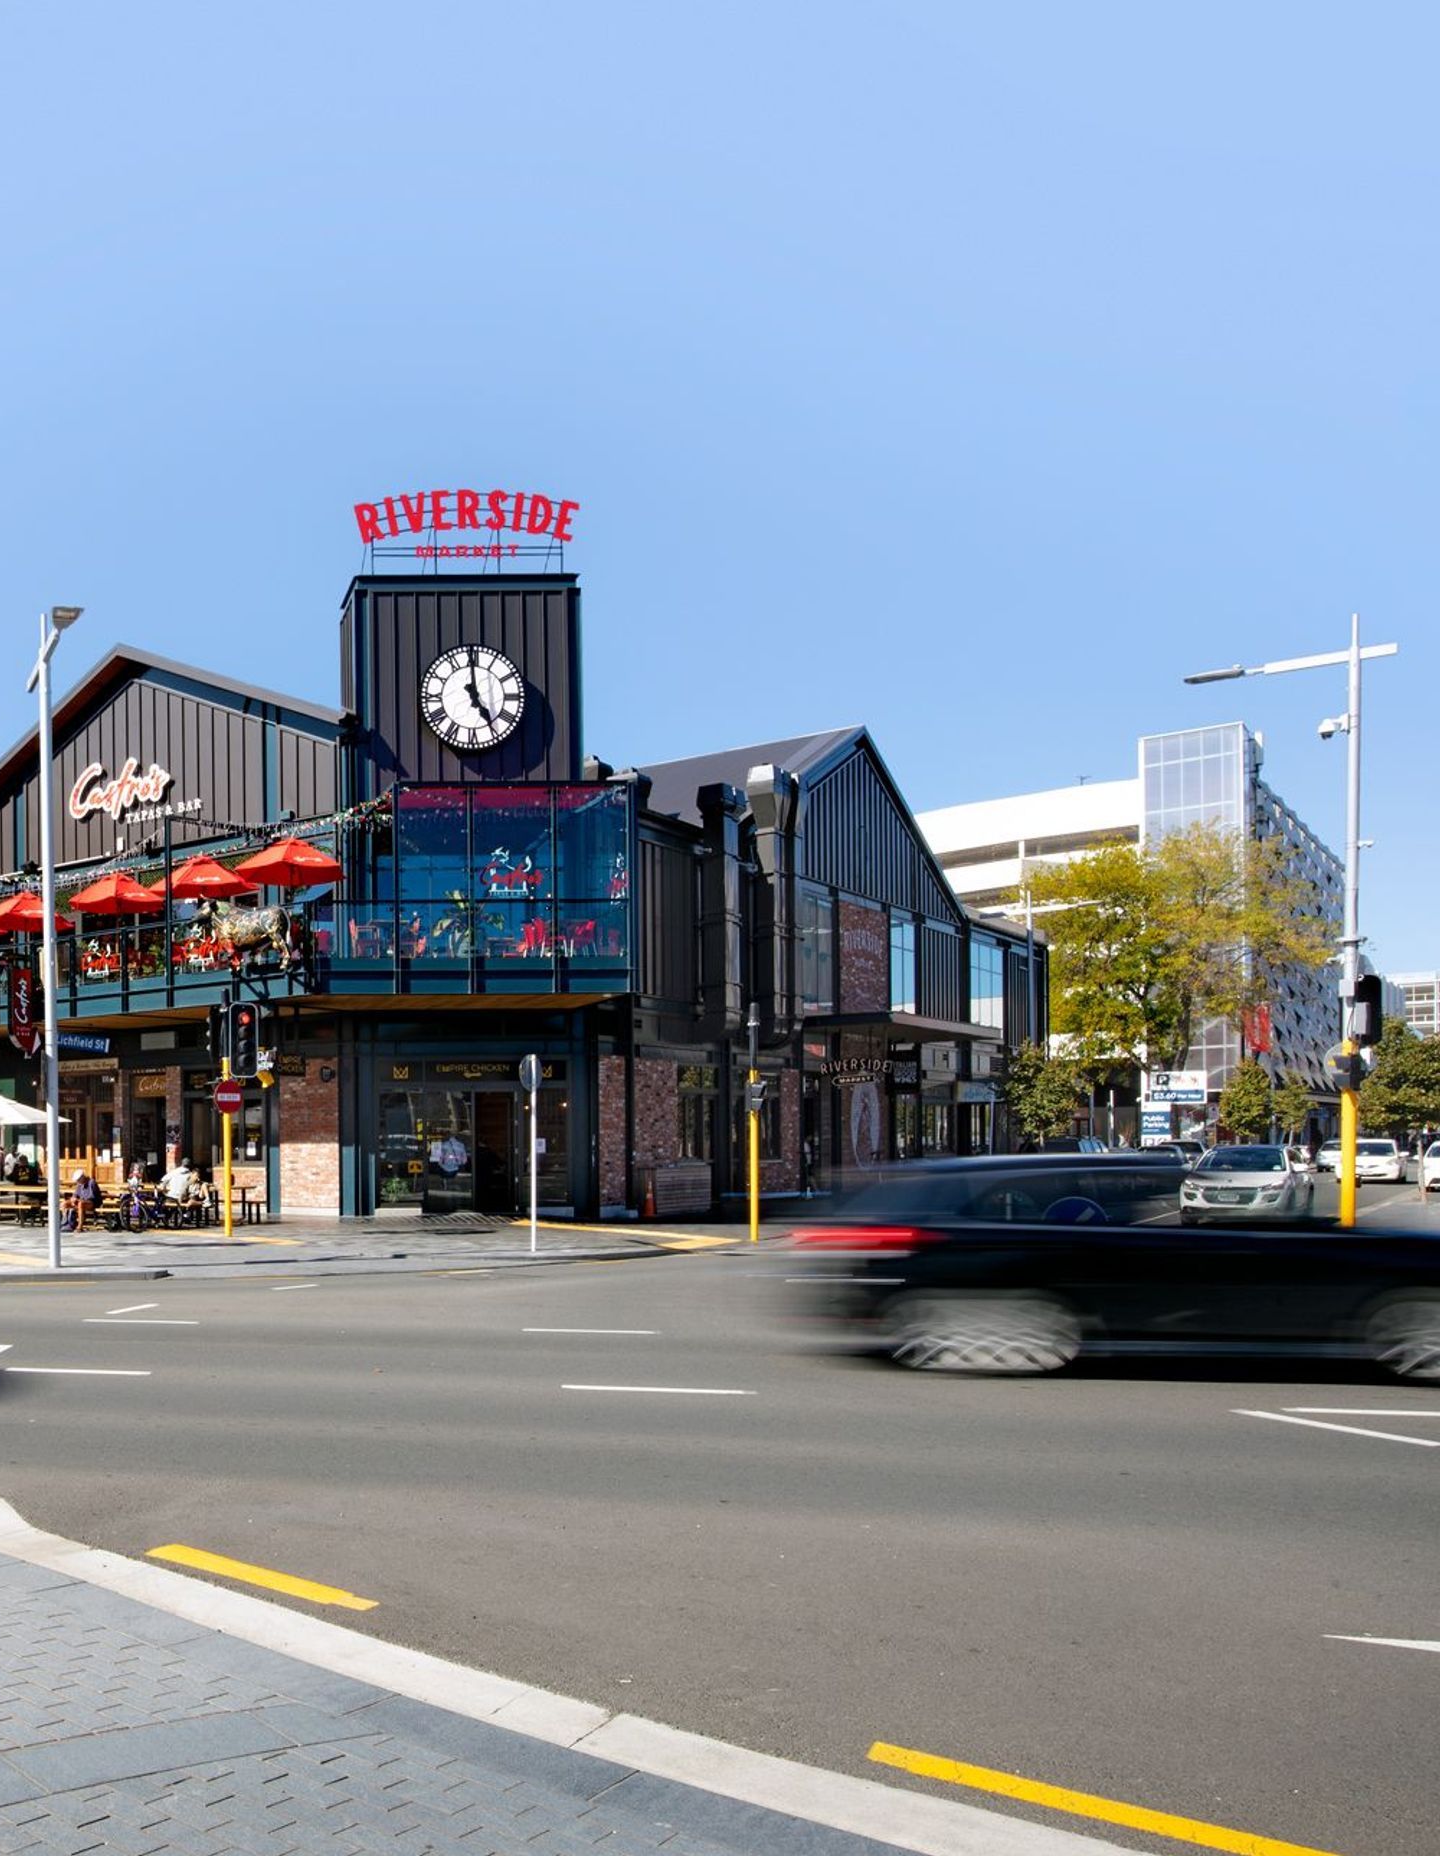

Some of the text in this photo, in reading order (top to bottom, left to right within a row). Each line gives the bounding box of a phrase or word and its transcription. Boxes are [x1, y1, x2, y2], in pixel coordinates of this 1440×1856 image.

[353, 488, 580, 544] RIVERSIDE
[416, 544, 519, 558] MARKET
[126, 811, 161, 824] TAPAS
[177, 798, 203, 814] BAR
[95, 1039, 105, 1049] St
[471, 1063, 510, 1072] CHICKEN
[820, 1059, 890, 1074] RIVERSIDE
